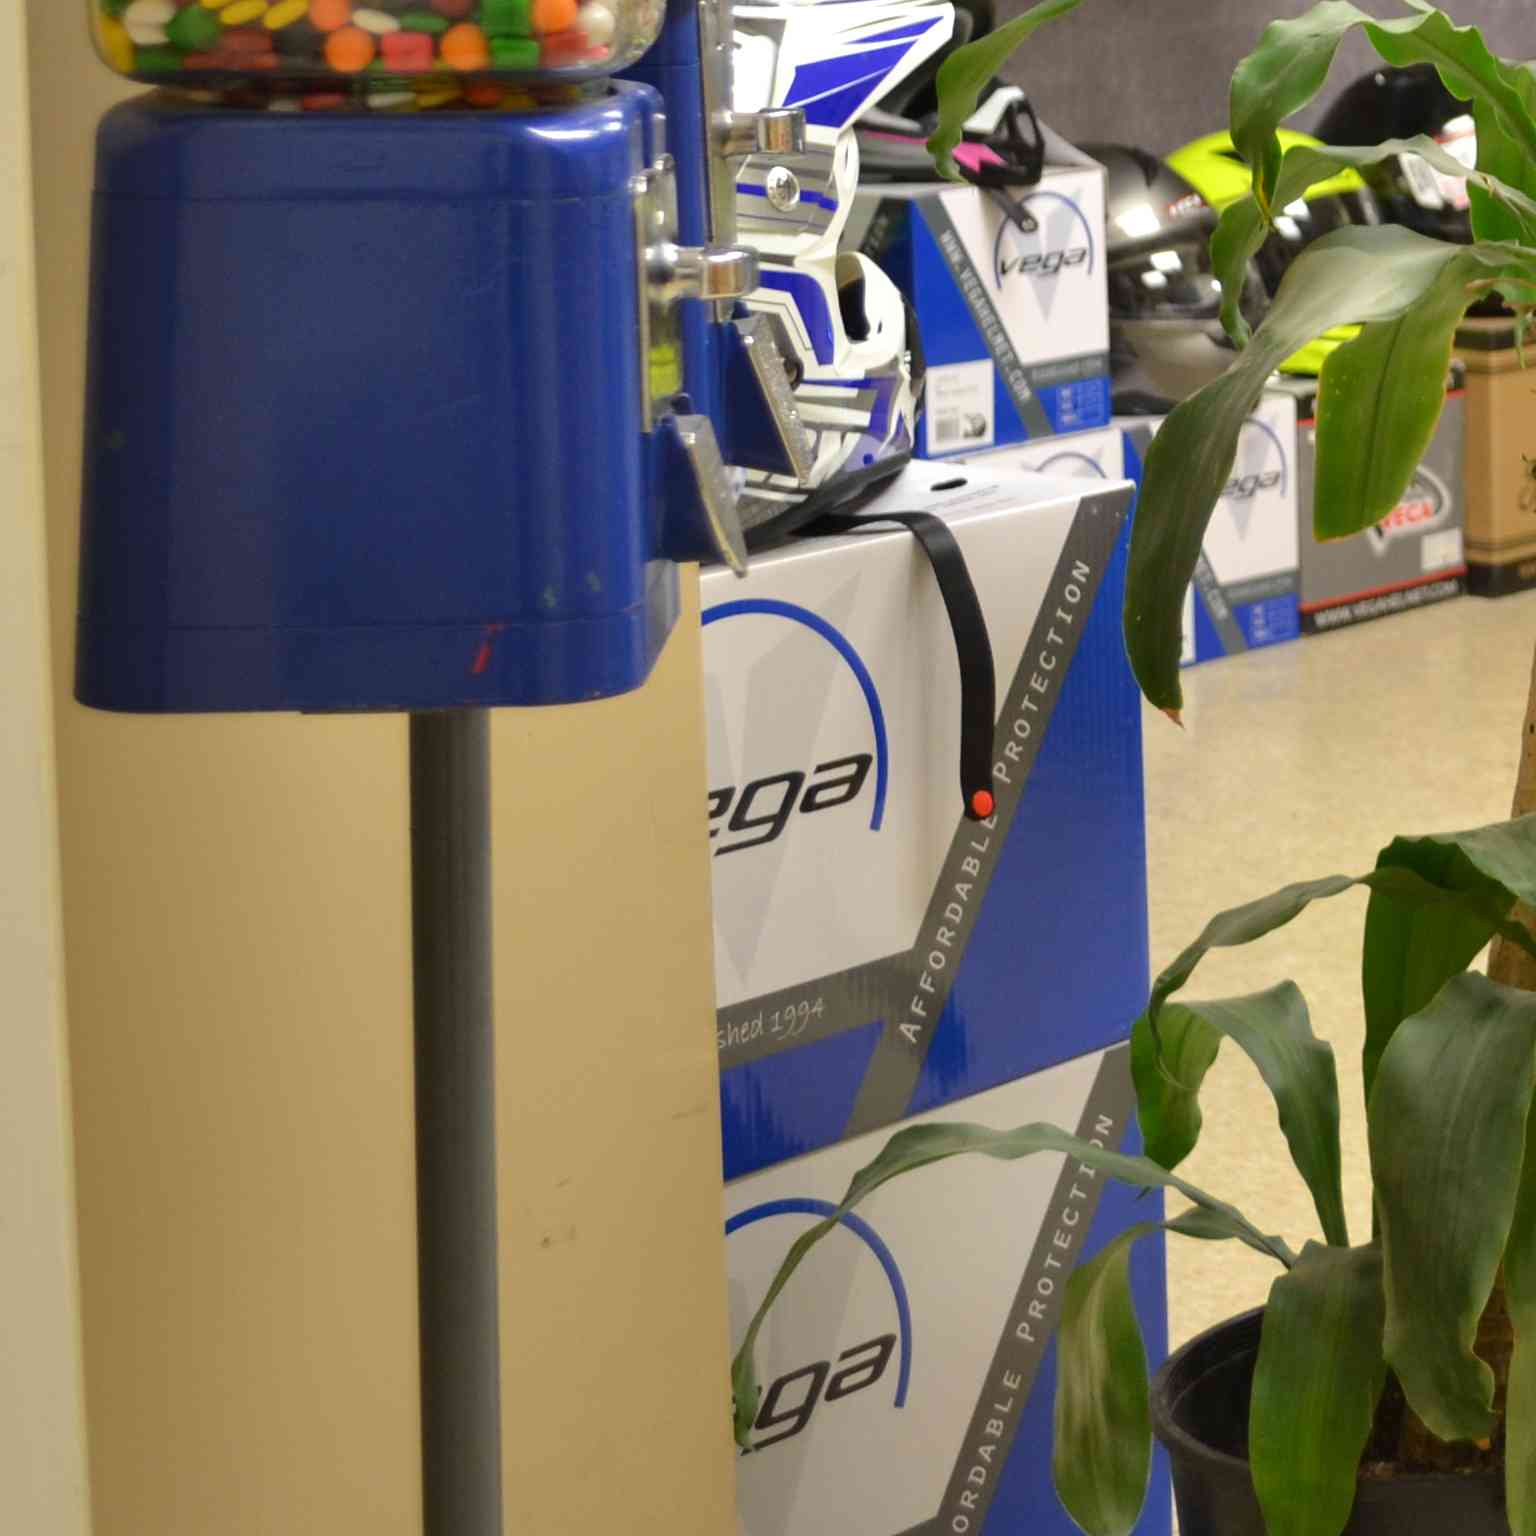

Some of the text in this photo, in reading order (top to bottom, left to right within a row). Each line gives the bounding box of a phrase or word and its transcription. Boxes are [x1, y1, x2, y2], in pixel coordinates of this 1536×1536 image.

[1000, 246, 1088, 276] vega
[1222, 469, 1281, 499] ega
[708, 752, 874, 856] ega
[899, 559, 1092, 1043] AFFORDABLE PROTECTION
[770, 996, 824, 1041] 1994
[740, 1333, 897, 1456] ga
[952, 1370, 1023, 1535] ORDABLE
